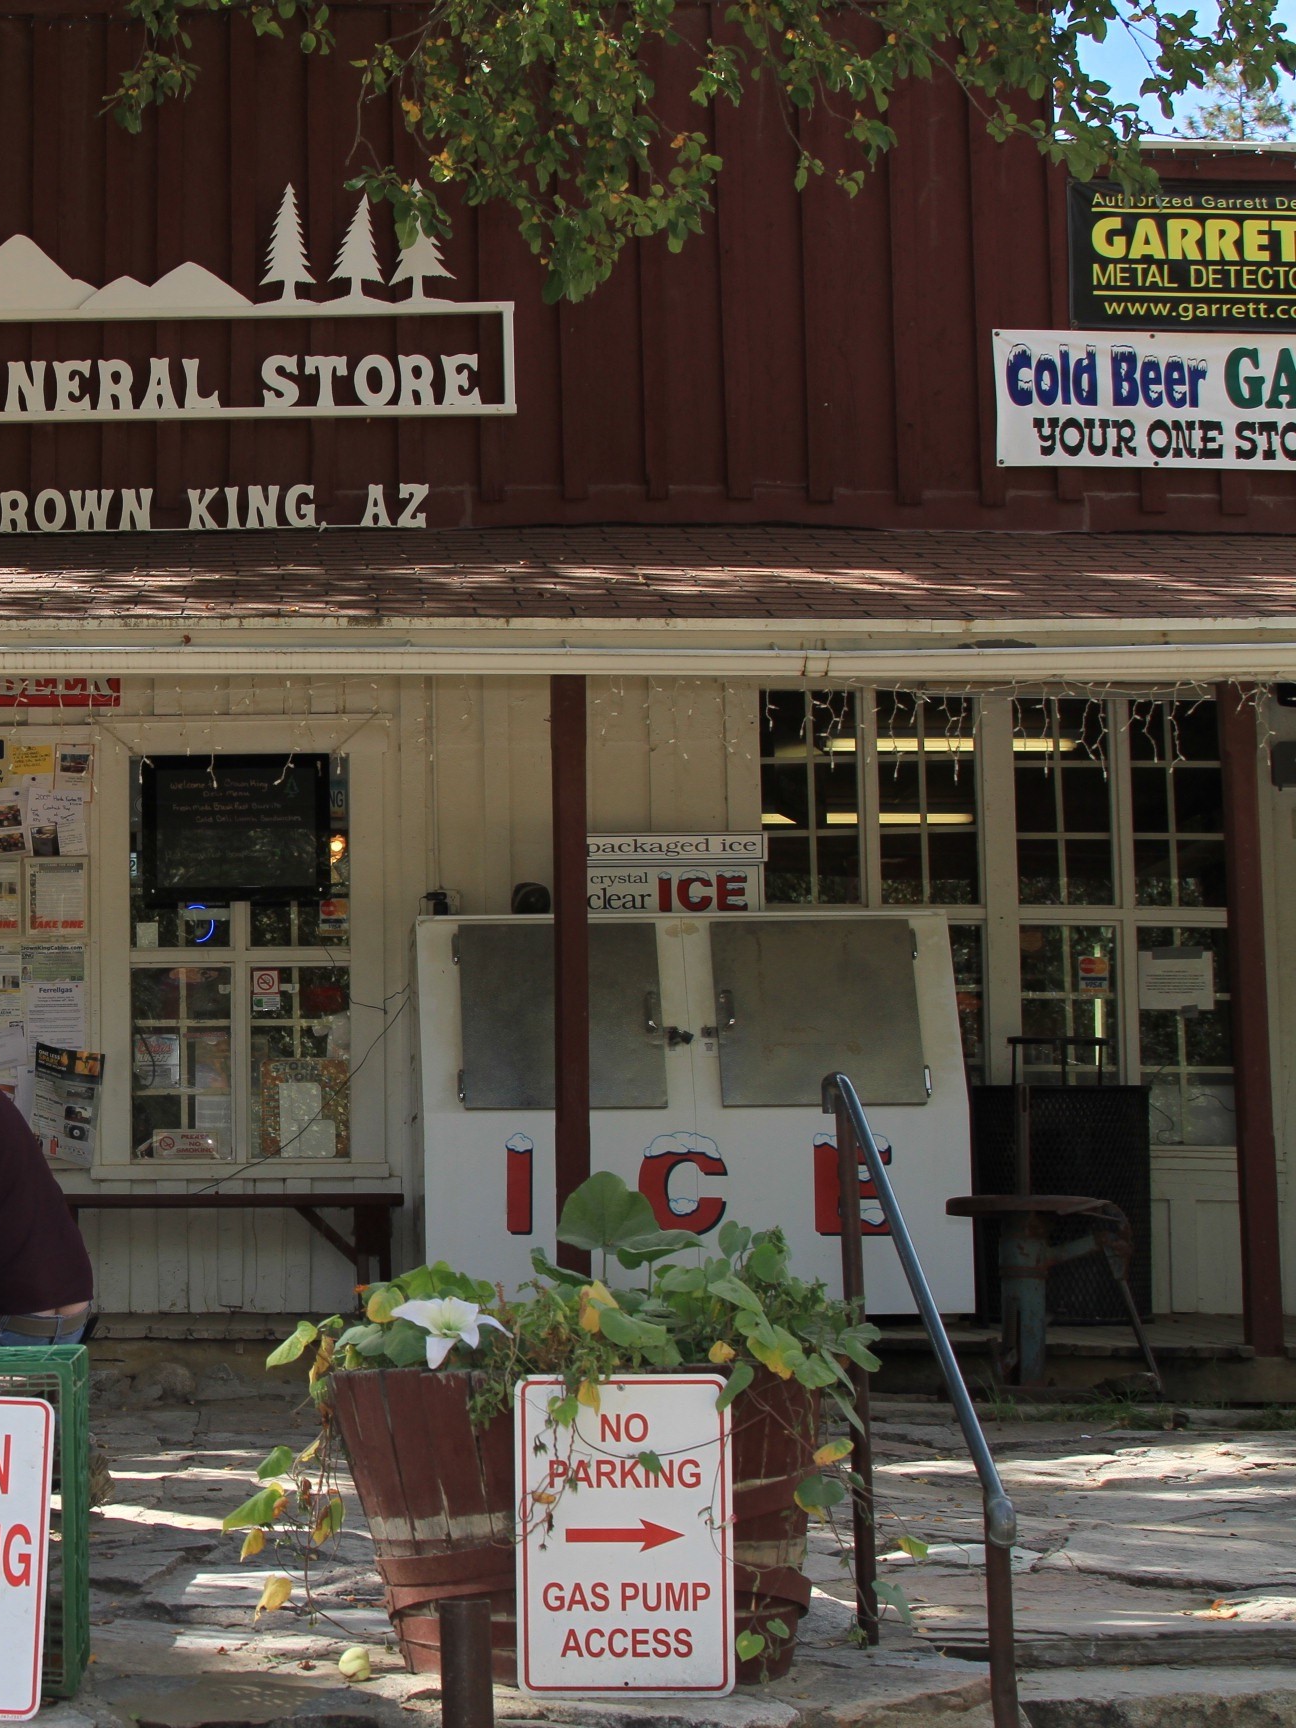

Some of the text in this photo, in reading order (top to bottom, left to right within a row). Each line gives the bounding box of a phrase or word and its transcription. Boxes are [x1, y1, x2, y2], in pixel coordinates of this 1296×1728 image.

[1201, 196, 1268, 209] Garrett
[1093, 264, 1178, 287] METAL
[263, 353, 482, 408] STORE
[1006, 343, 1098, 407] Cold
[1110, 344, 1208, 409] Beer
[1032, 416, 1137, 458] YOUR
[1147, 418, 1224, 460] ONE
[360, 482, 430, 529] AZ
[587, 837, 757, 858] packaged ice
[587, 869, 749, 912] clear ICE
[590, 871, 649, 888] crystal
[61, 919, 85, 929] ONE
[38, 986, 73, 995] Ferrellgas
[600, 1413, 649, 1442] NO
[549, 1459, 701, 1489] PARKING
[542, 1582, 711, 1612] GAS PUMP
[560, 1628, 693, 1658] ACCESS
